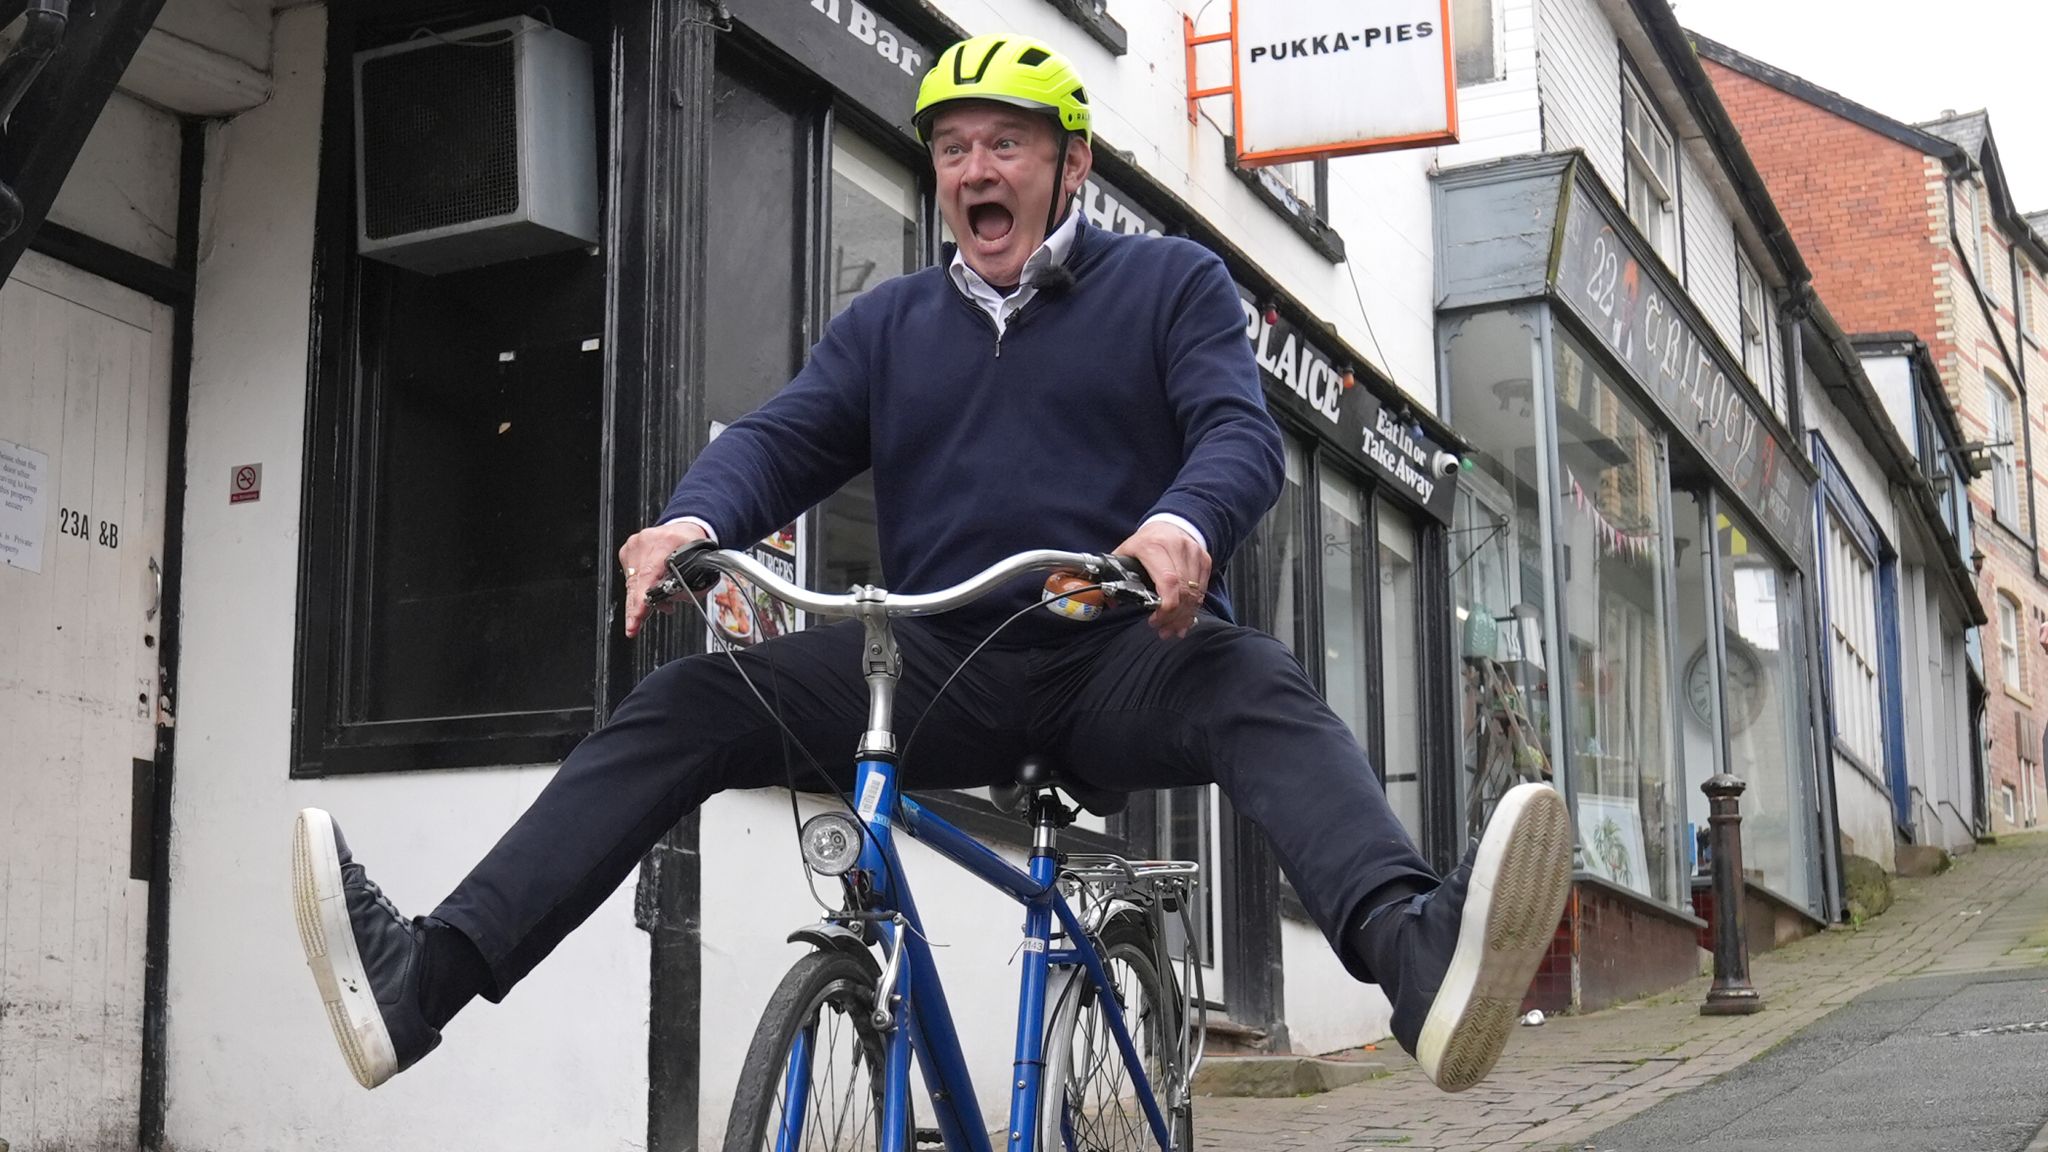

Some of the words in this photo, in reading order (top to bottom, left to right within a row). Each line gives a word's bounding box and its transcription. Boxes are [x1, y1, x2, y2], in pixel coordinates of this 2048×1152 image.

[848, 0, 921, 76] Bar
[1251, 22, 1433, 62] PUKKA-PIES
[1586, 237, 1617, 316] 22
[1241, 297, 1344, 424] PLAICE
[1362, 427, 1396, 472] Take
[1394, 455, 1434, 505] Away
[1376, 408, 1399, 445] Eat
[1413, 446, 1427, 467] or
[61, 507, 89, 541] 23A
[99, 520, 118, 549] &B
